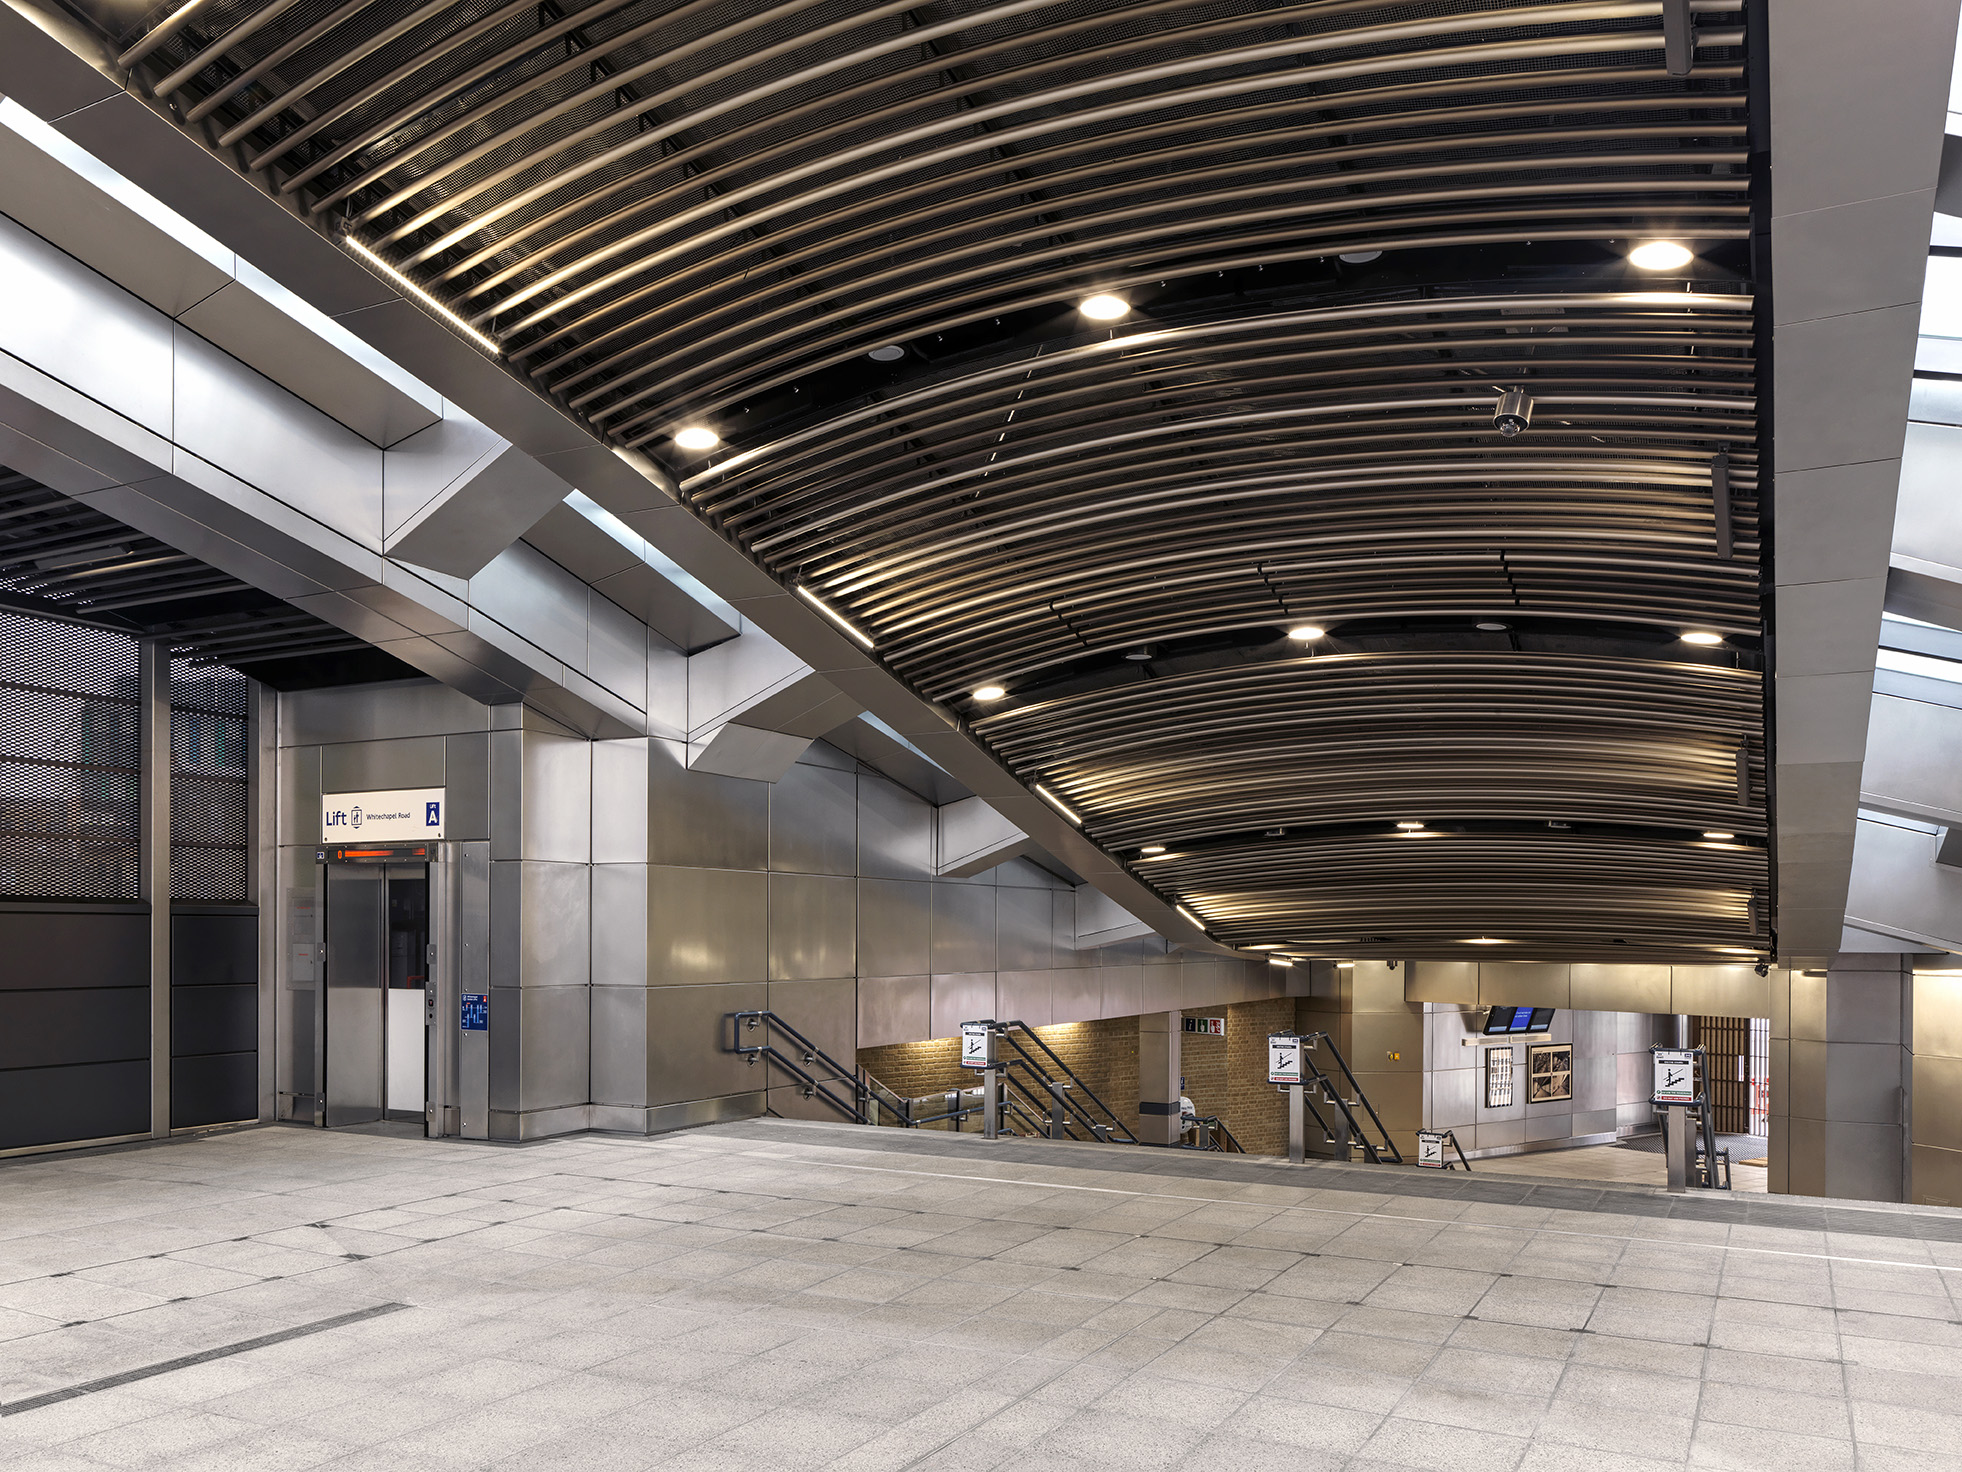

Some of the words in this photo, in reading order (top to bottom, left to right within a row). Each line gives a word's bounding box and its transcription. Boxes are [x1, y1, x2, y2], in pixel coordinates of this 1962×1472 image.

[326, 811, 347, 826] Lift
[366, 812, 397, 821] Whitechapel
[428, 810, 438, 824] A
